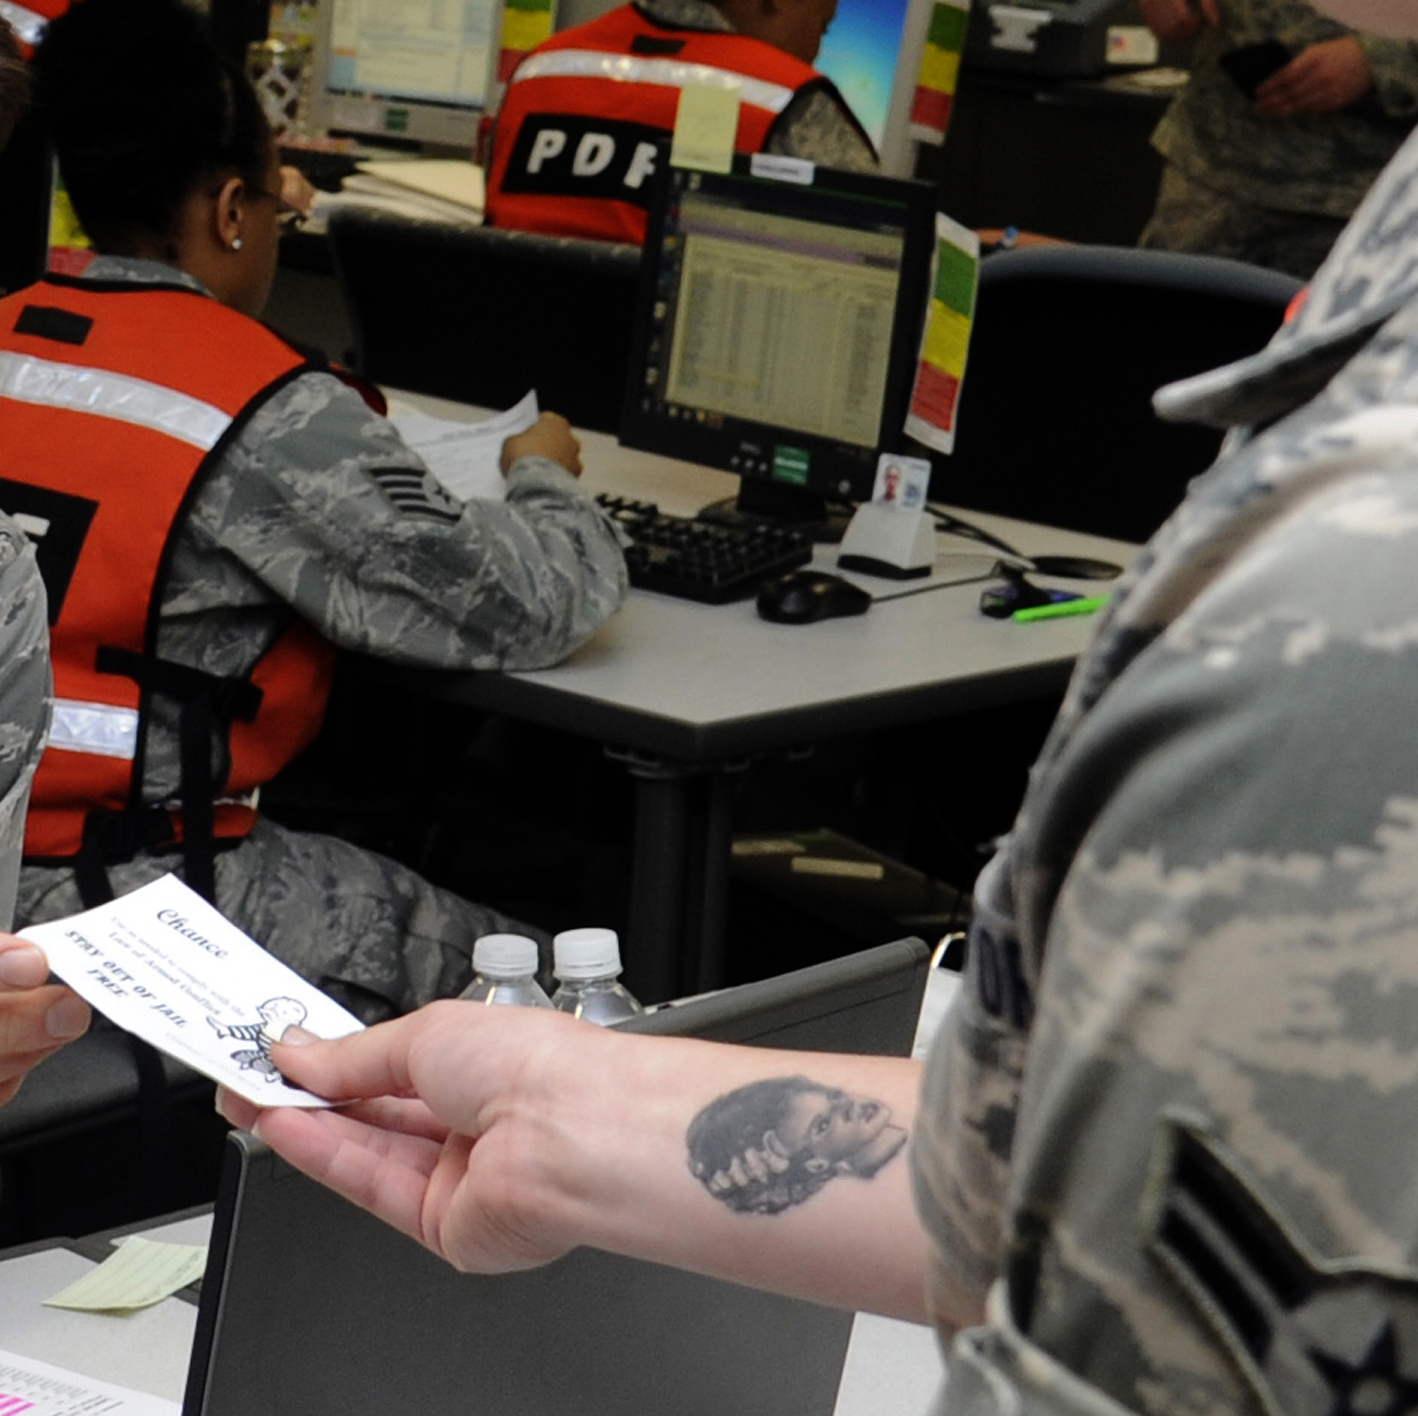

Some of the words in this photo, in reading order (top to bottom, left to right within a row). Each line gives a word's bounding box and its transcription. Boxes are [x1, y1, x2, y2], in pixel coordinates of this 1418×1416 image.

[526, 127, 658, 189] PDF
[156, 908, 228, 959] Chance
[64, 930, 106, 957] STAY
[102, 960, 135, 983] OUT
[132, 985, 158, 1000] OF
[148, 1003, 189, 1029] JAIL
[86, 969, 129, 997] FREE
[143, 959, 180, 985] Armed
[179, 983, 221, 1015] Conflict
